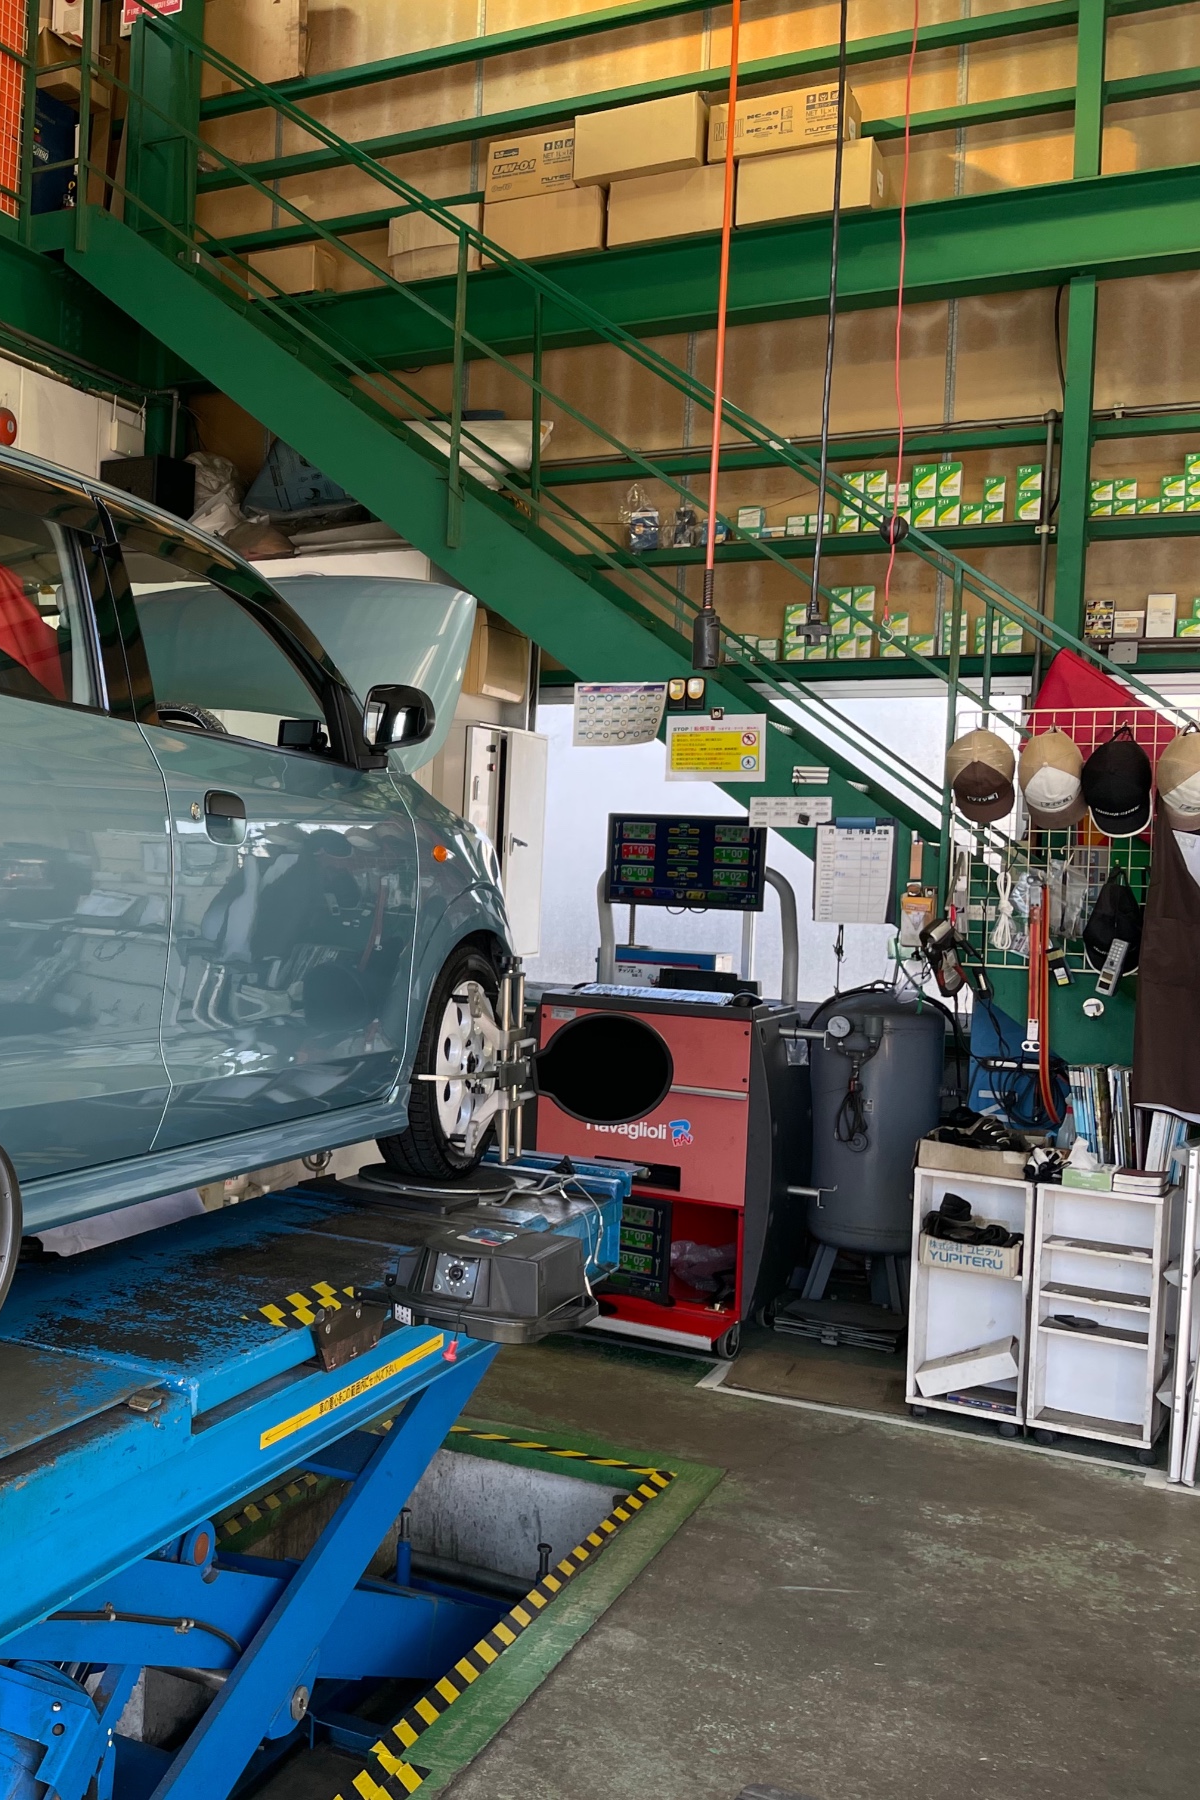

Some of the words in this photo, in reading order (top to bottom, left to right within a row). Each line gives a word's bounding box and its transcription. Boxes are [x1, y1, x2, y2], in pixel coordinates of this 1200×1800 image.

[126, 7, 140, 16] FIRE
[929, 1239, 963, 1253] 株式会社
[967, 1245, 1003, 1258] ユピテル
[929, 1249, 1003, 1270] YUPITERU
